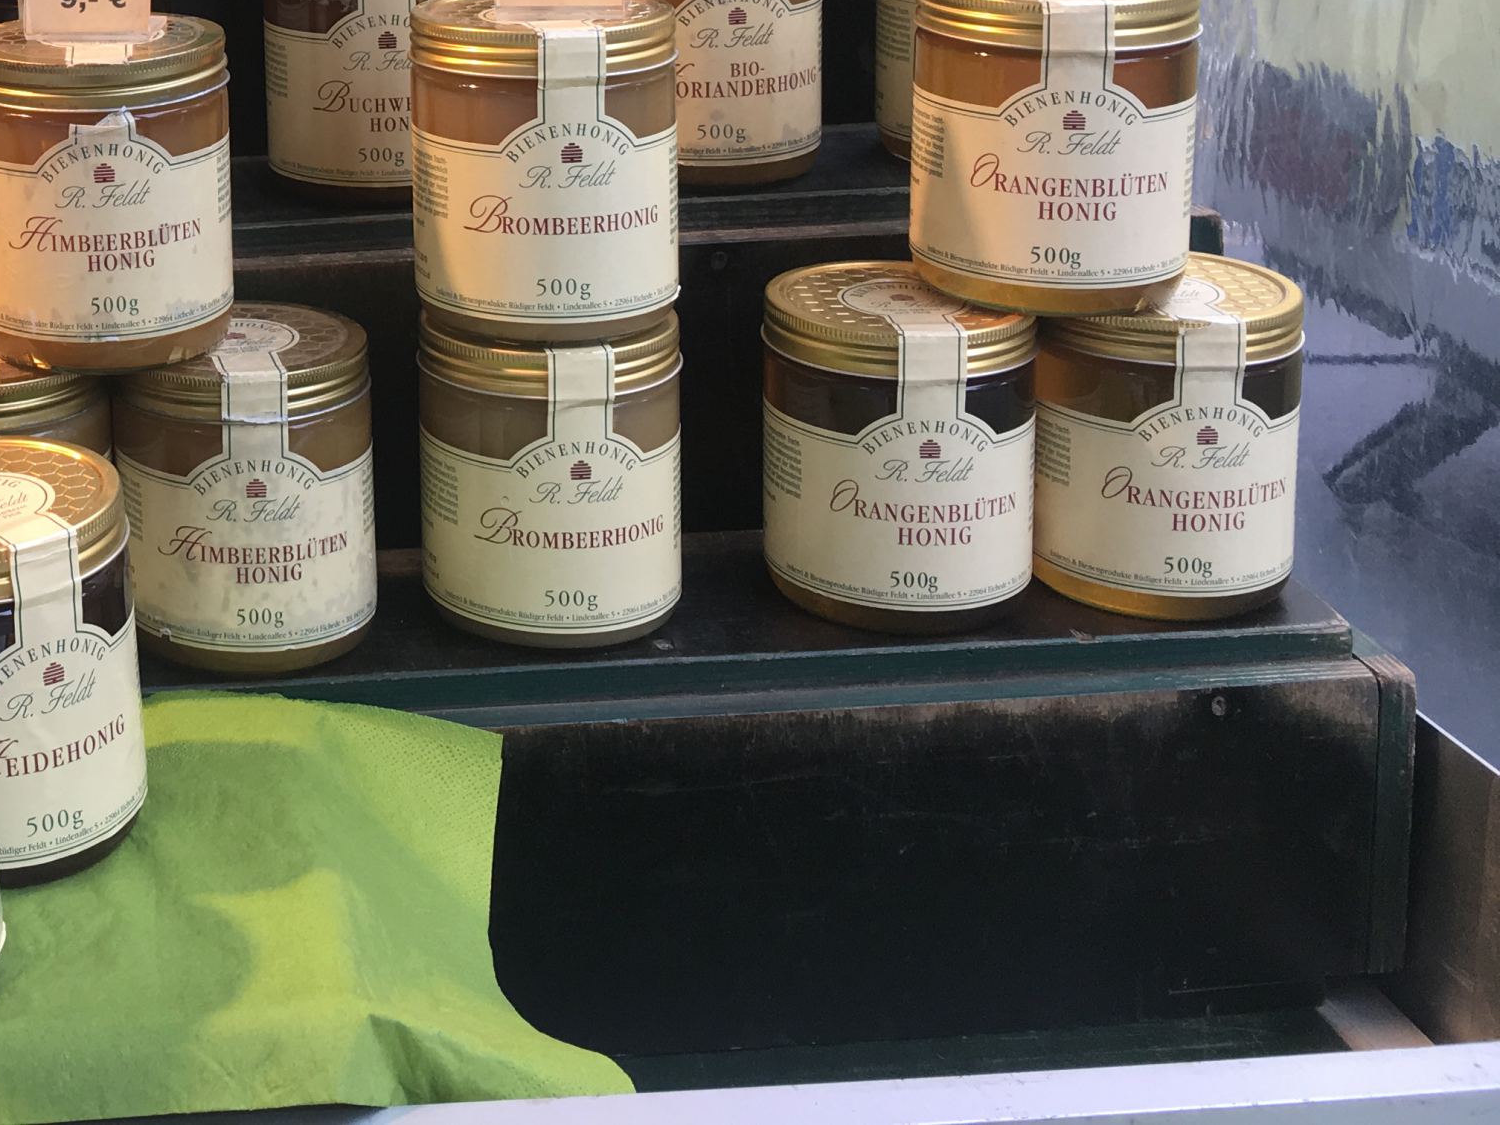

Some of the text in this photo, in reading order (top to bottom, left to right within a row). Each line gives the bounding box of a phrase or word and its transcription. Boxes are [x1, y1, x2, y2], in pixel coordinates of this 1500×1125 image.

[970, 152, 1168, 196] ORANGENBLÜTEN
[464, 194, 658, 235] BROMBEERHONIG
[1037, 201, 1117, 221] HONIG
[9, 215, 200, 253] HIMBEERBLÜTEN
[88, 250, 155, 272] HONIG
[1102, 466, 1286, 510] ORANGENBLÜTEN
[1171, 511, 1245, 533] HONIG
[1163, 556, 1213, 577] 500g
